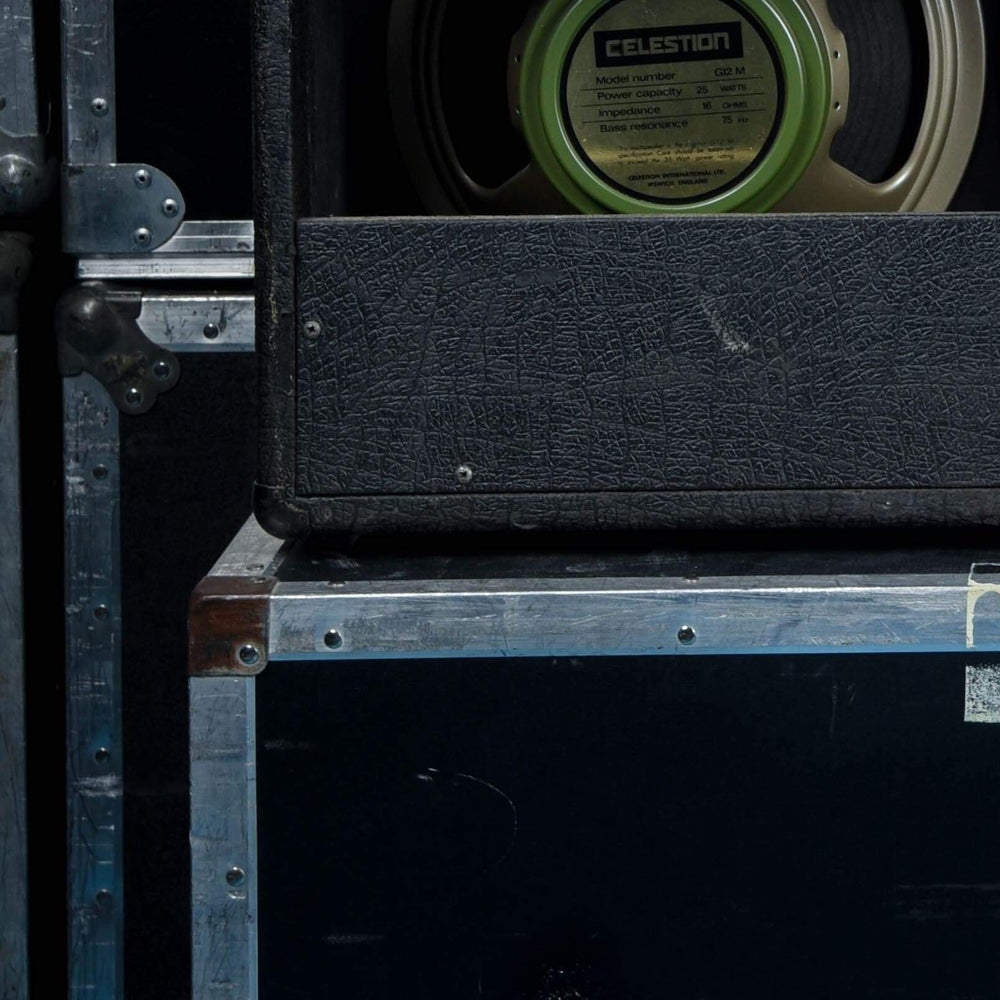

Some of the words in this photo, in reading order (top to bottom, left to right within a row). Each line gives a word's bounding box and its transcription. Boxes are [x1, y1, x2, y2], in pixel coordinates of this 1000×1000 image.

[605, 32, 730, 58] CELESTION
[596, 75, 629, 85] Model
[632, 72, 676, 82] number
[735, 66, 746, 75] M
[597, 91, 632, 101] Power
[635, 87, 682, 99] capacity
[696, 86, 708, 94] 25
[598, 106, 660, 118] Impedance
[702, 102, 712, 110] 16
[600, 122, 627, 133] Bass
[630, 120, 688, 131] resonance
[721, 116, 733, 125] 75
